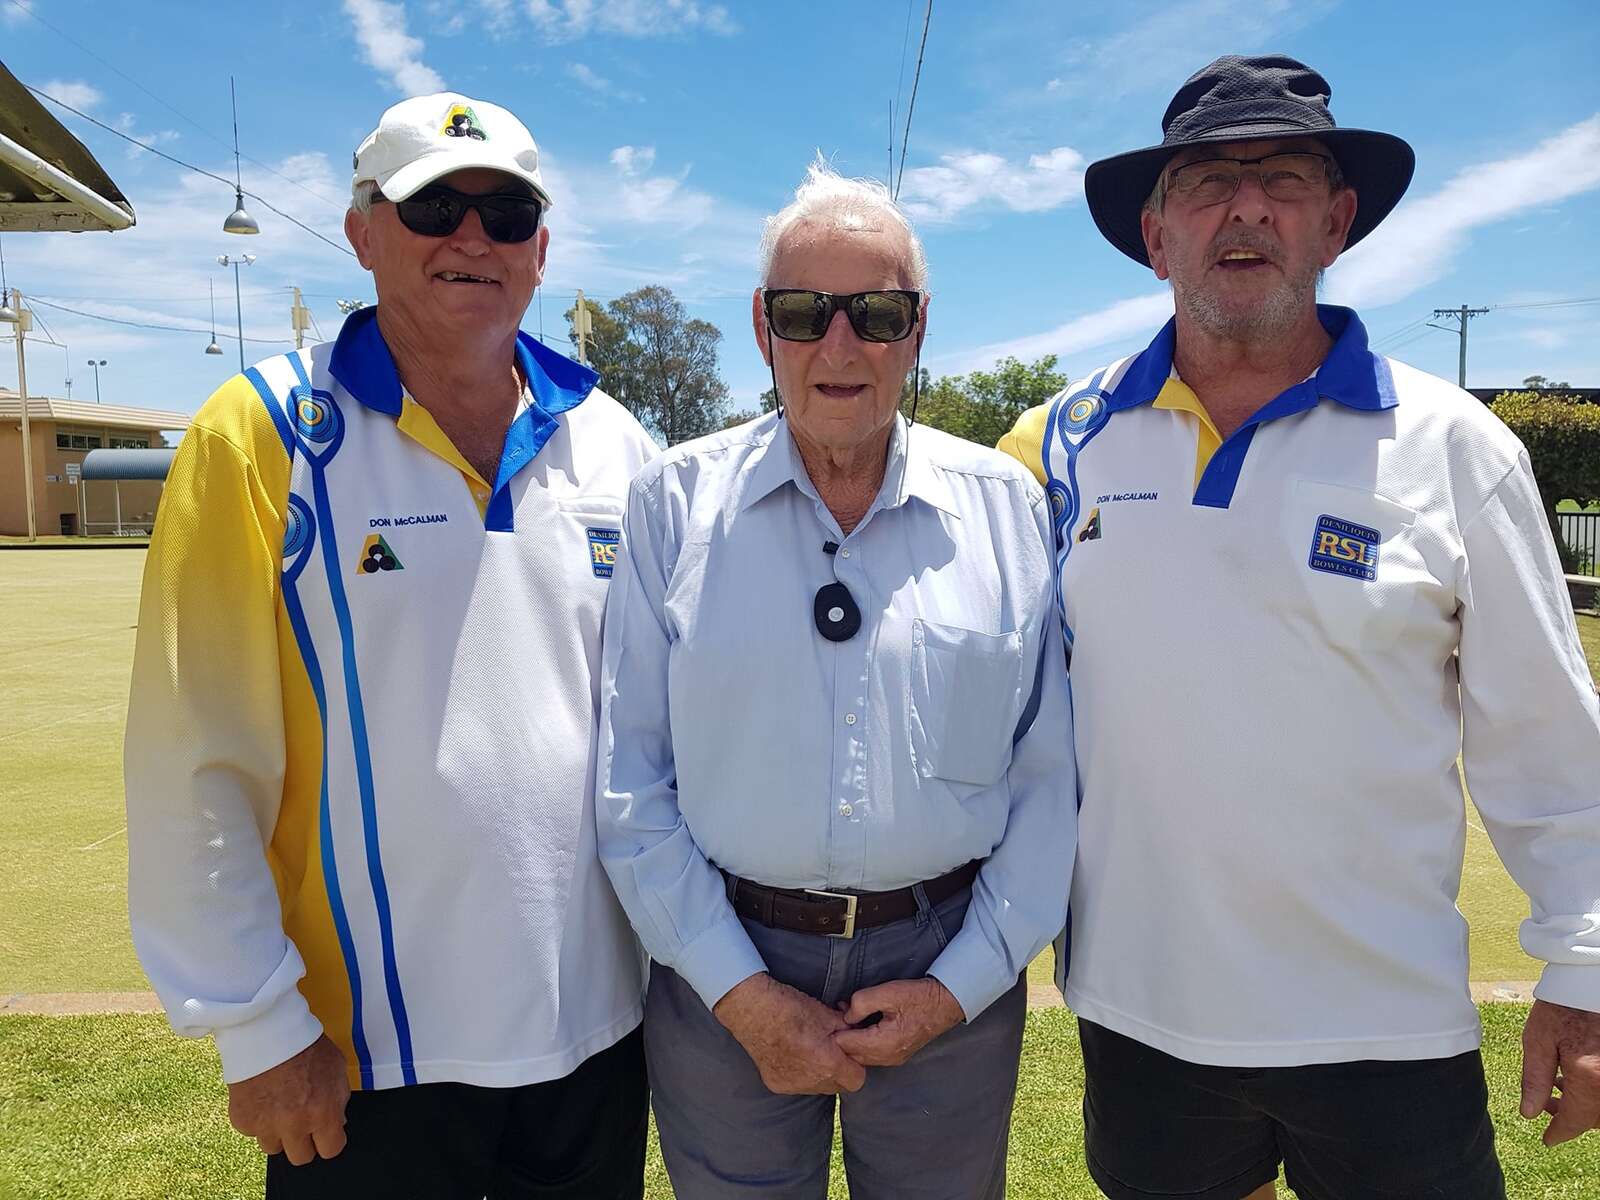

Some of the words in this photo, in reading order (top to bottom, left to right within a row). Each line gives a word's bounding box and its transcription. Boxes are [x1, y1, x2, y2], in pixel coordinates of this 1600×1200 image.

[1096, 495, 1111, 504] DON
[1112, 492, 1158, 502] McCALMAN
[369, 518, 391, 527] DON
[394, 514, 448, 526] McCALMAN
[1321, 519, 1377, 541] DENILIQUIN
[1317, 531, 1374, 566] RSL
[1313, 559, 1347, 572] BOWLS
